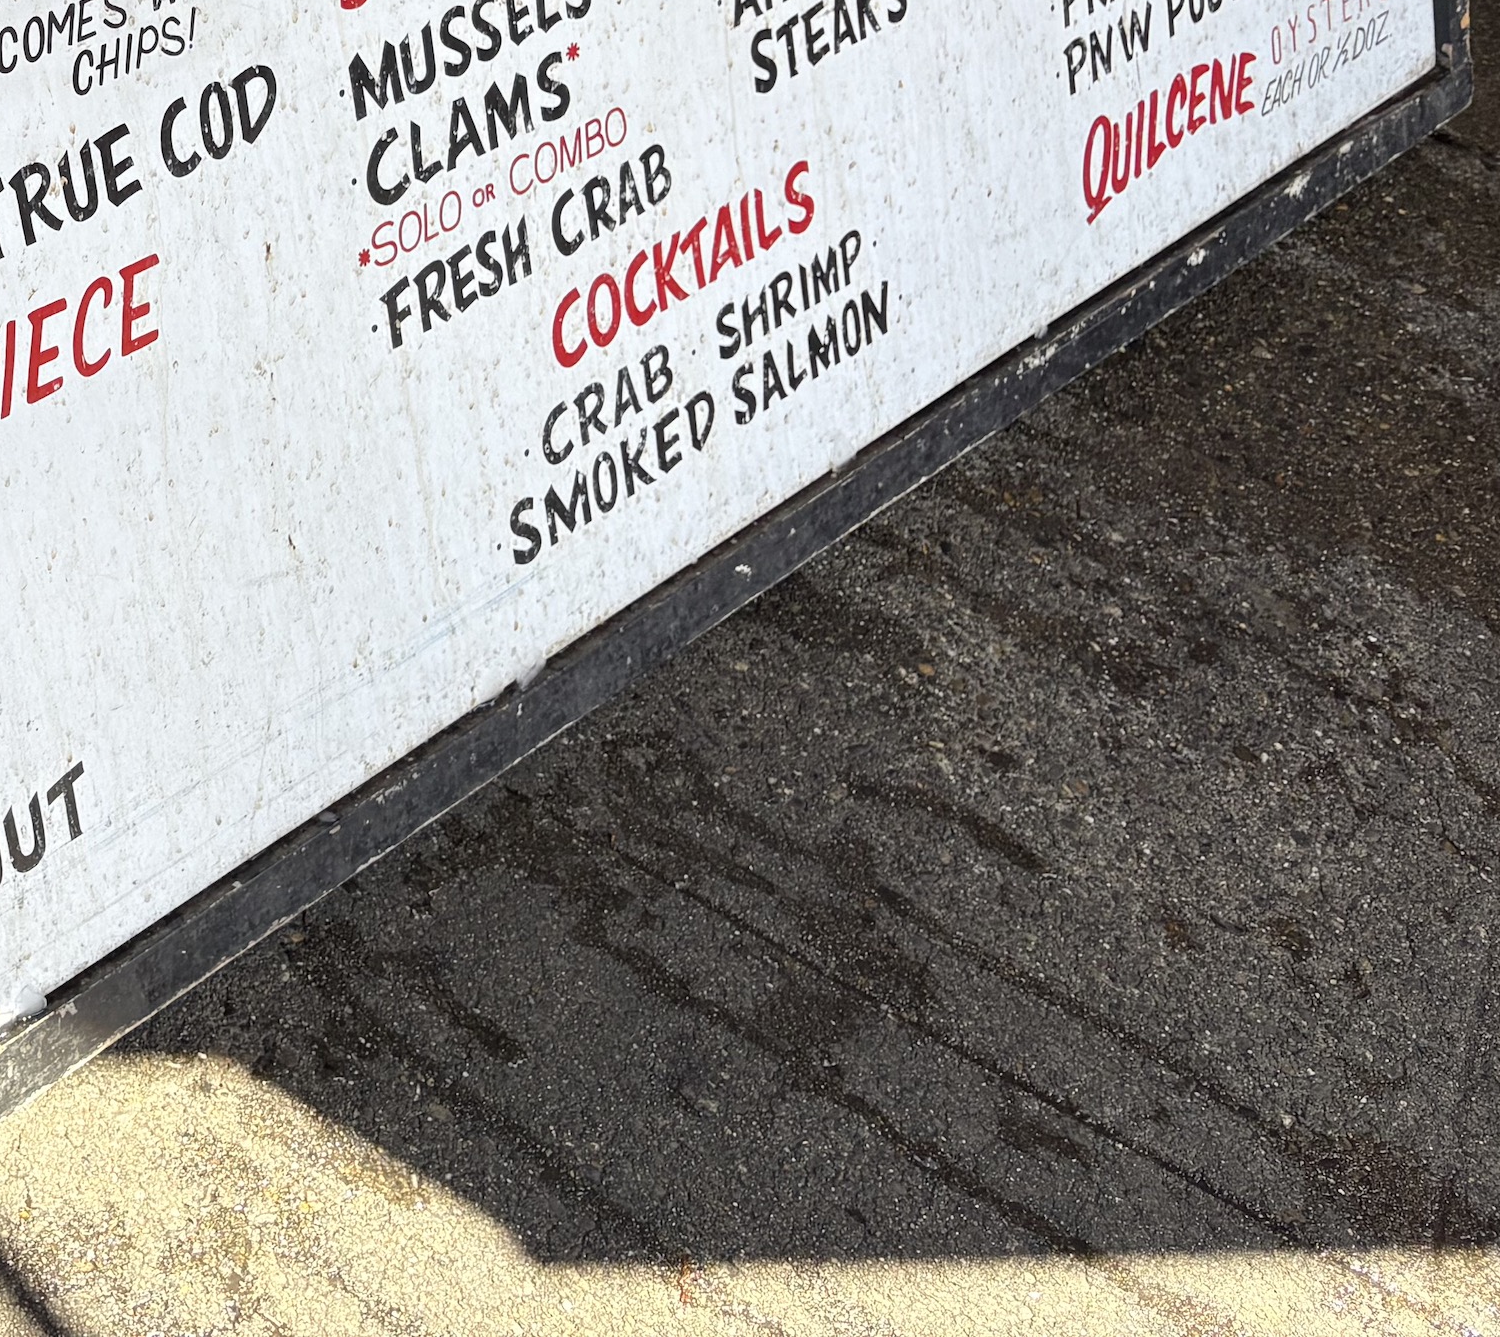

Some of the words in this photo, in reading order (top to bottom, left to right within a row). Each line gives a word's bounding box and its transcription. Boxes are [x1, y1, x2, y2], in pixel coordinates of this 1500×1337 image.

[72, 6, 197, 96] CHIPS!
[1063, 1, 1153, 96] PNW
[1261, 60, 1305, 117] EACH
[1308, 46, 1330, 89] OR
[160, 64, 278, 178] COD
[509, 106, 627, 196] COMBO
[1082, 51, 1257, 225] QUILCENE
[379, 215, 533, 349] FRESH
[551, 143, 672, 257] CRAB
[551, 160, 815, 368] COCKTAILS
[542, 344, 674, 466] CRAB
[715, 229, 862, 360] SHRIMP
[509, 390, 716, 565] SMOKED
[731, 280, 889, 426] SALMON
